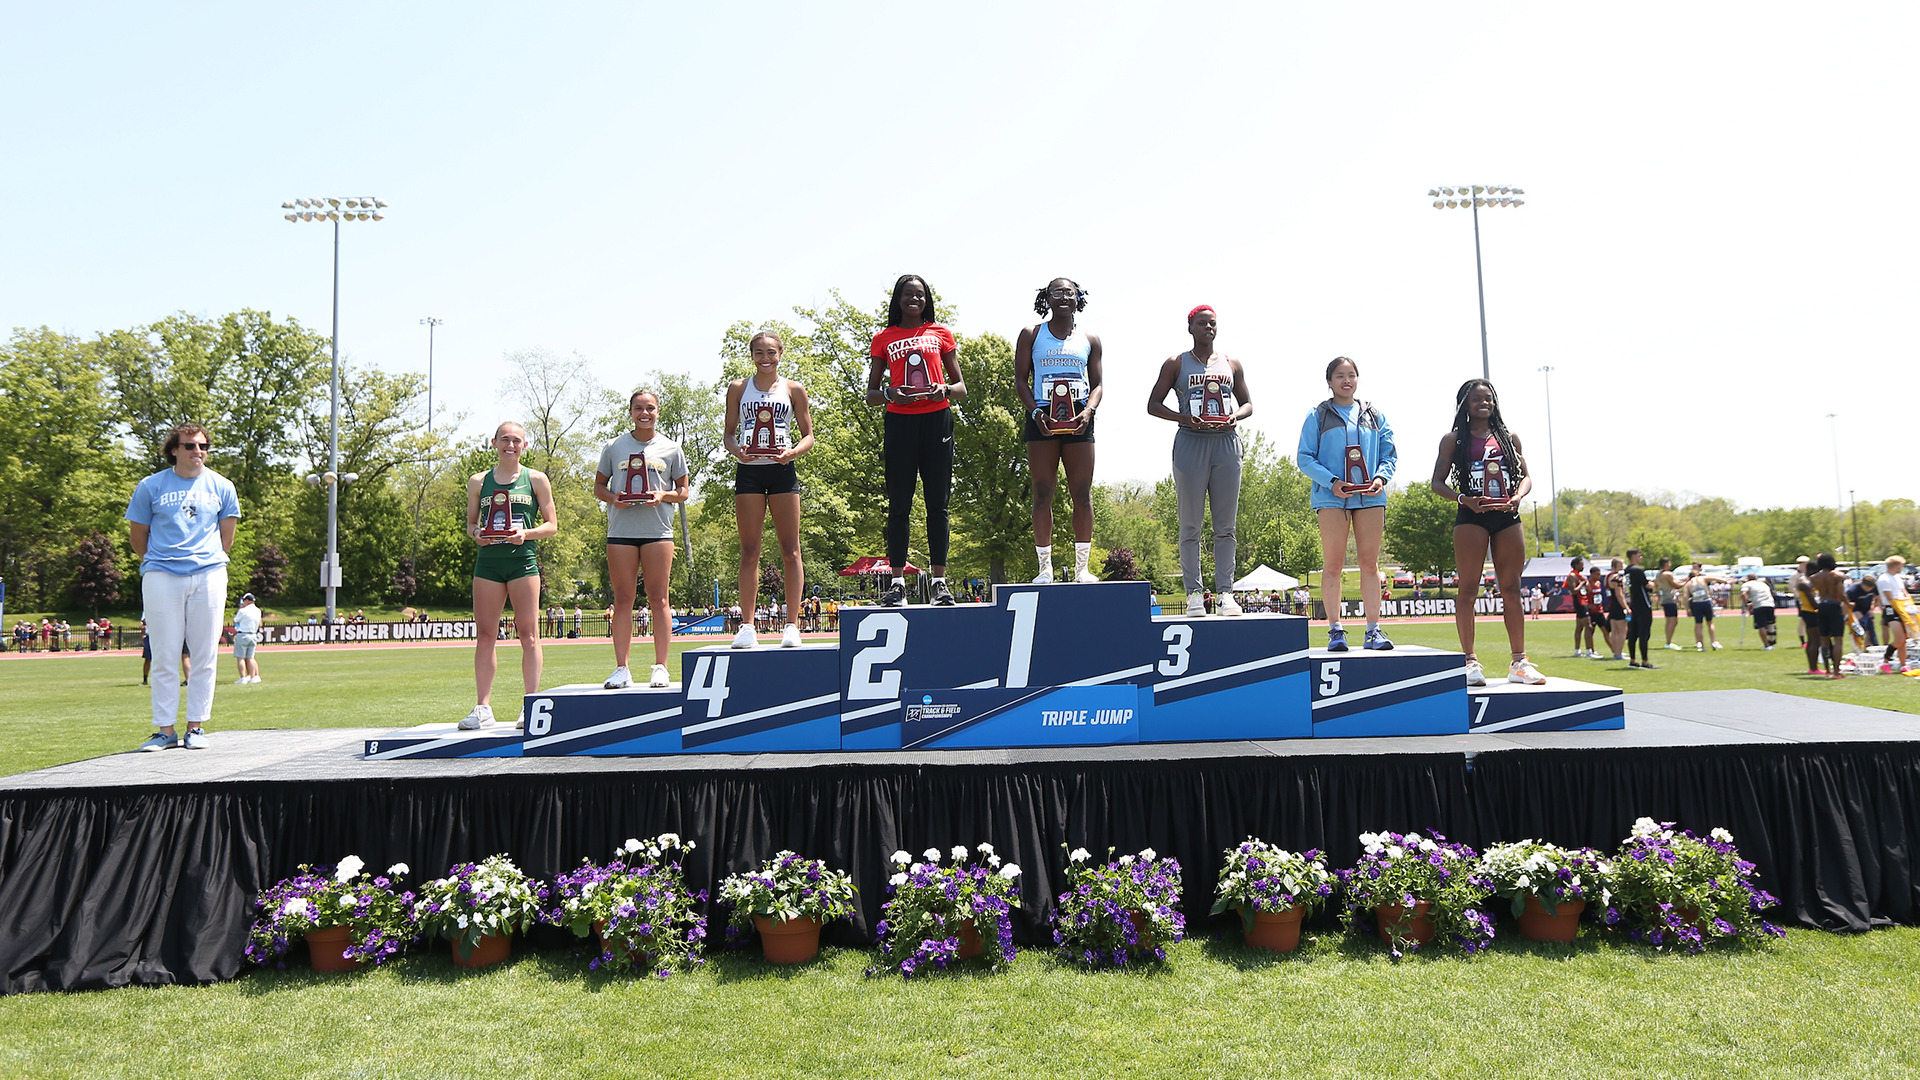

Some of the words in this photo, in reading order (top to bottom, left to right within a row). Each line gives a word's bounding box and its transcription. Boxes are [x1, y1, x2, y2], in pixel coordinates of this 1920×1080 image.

[1040, 358, 1083, 368] HOPKINS
[1354, 601, 1398, 616] JHN
[1401, 599, 1456, 615] FISHER
[280, 625, 326, 642] JOHN
[330, 623, 389, 641] FISHER
[392, 621, 478, 640] UNIVERSIT
[1005, 591, 1039, 688] 1
[848, 612, 908, 700] 2
[1158, 624, 1193, 676] 3
[688, 656, 730, 718] 4
[1319, 661, 1341, 697] 5
[529, 698, 554, 736] 6
[1042, 710, 1087, 726] TRIPLE
[1091, 709, 1134, 725] JUMP
[1474, 697, 1490, 723] 7
[369, 741, 378, 754] 8
